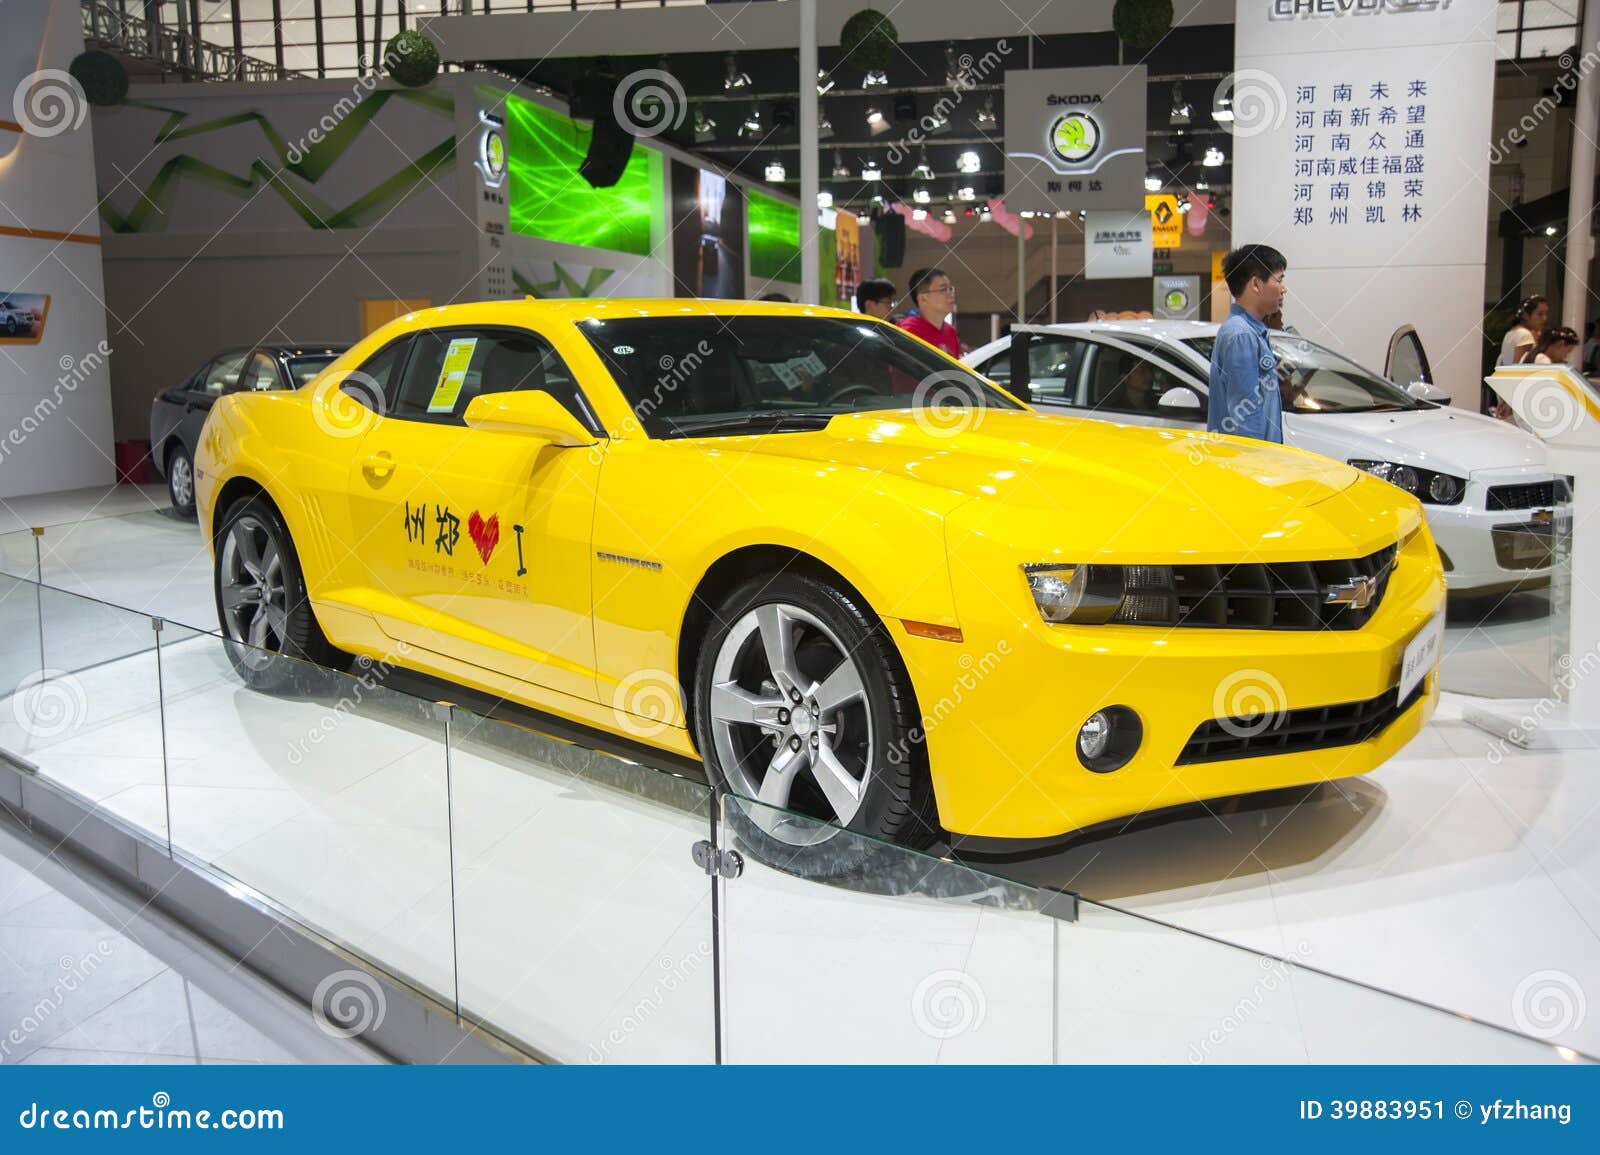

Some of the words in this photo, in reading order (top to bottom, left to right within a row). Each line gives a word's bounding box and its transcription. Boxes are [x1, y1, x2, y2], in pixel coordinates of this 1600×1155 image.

[1296, 80, 1427, 104] 河南未来
[1295, 105, 1427, 128] 河南新希望
[1294, 129, 1425, 152] 河南众通
[1294, 154, 1424, 177] 河南威佳福盛
[1294, 178, 1424, 201] 河南锦荣
[1293, 203, 1423, 226] 郑州凯林
